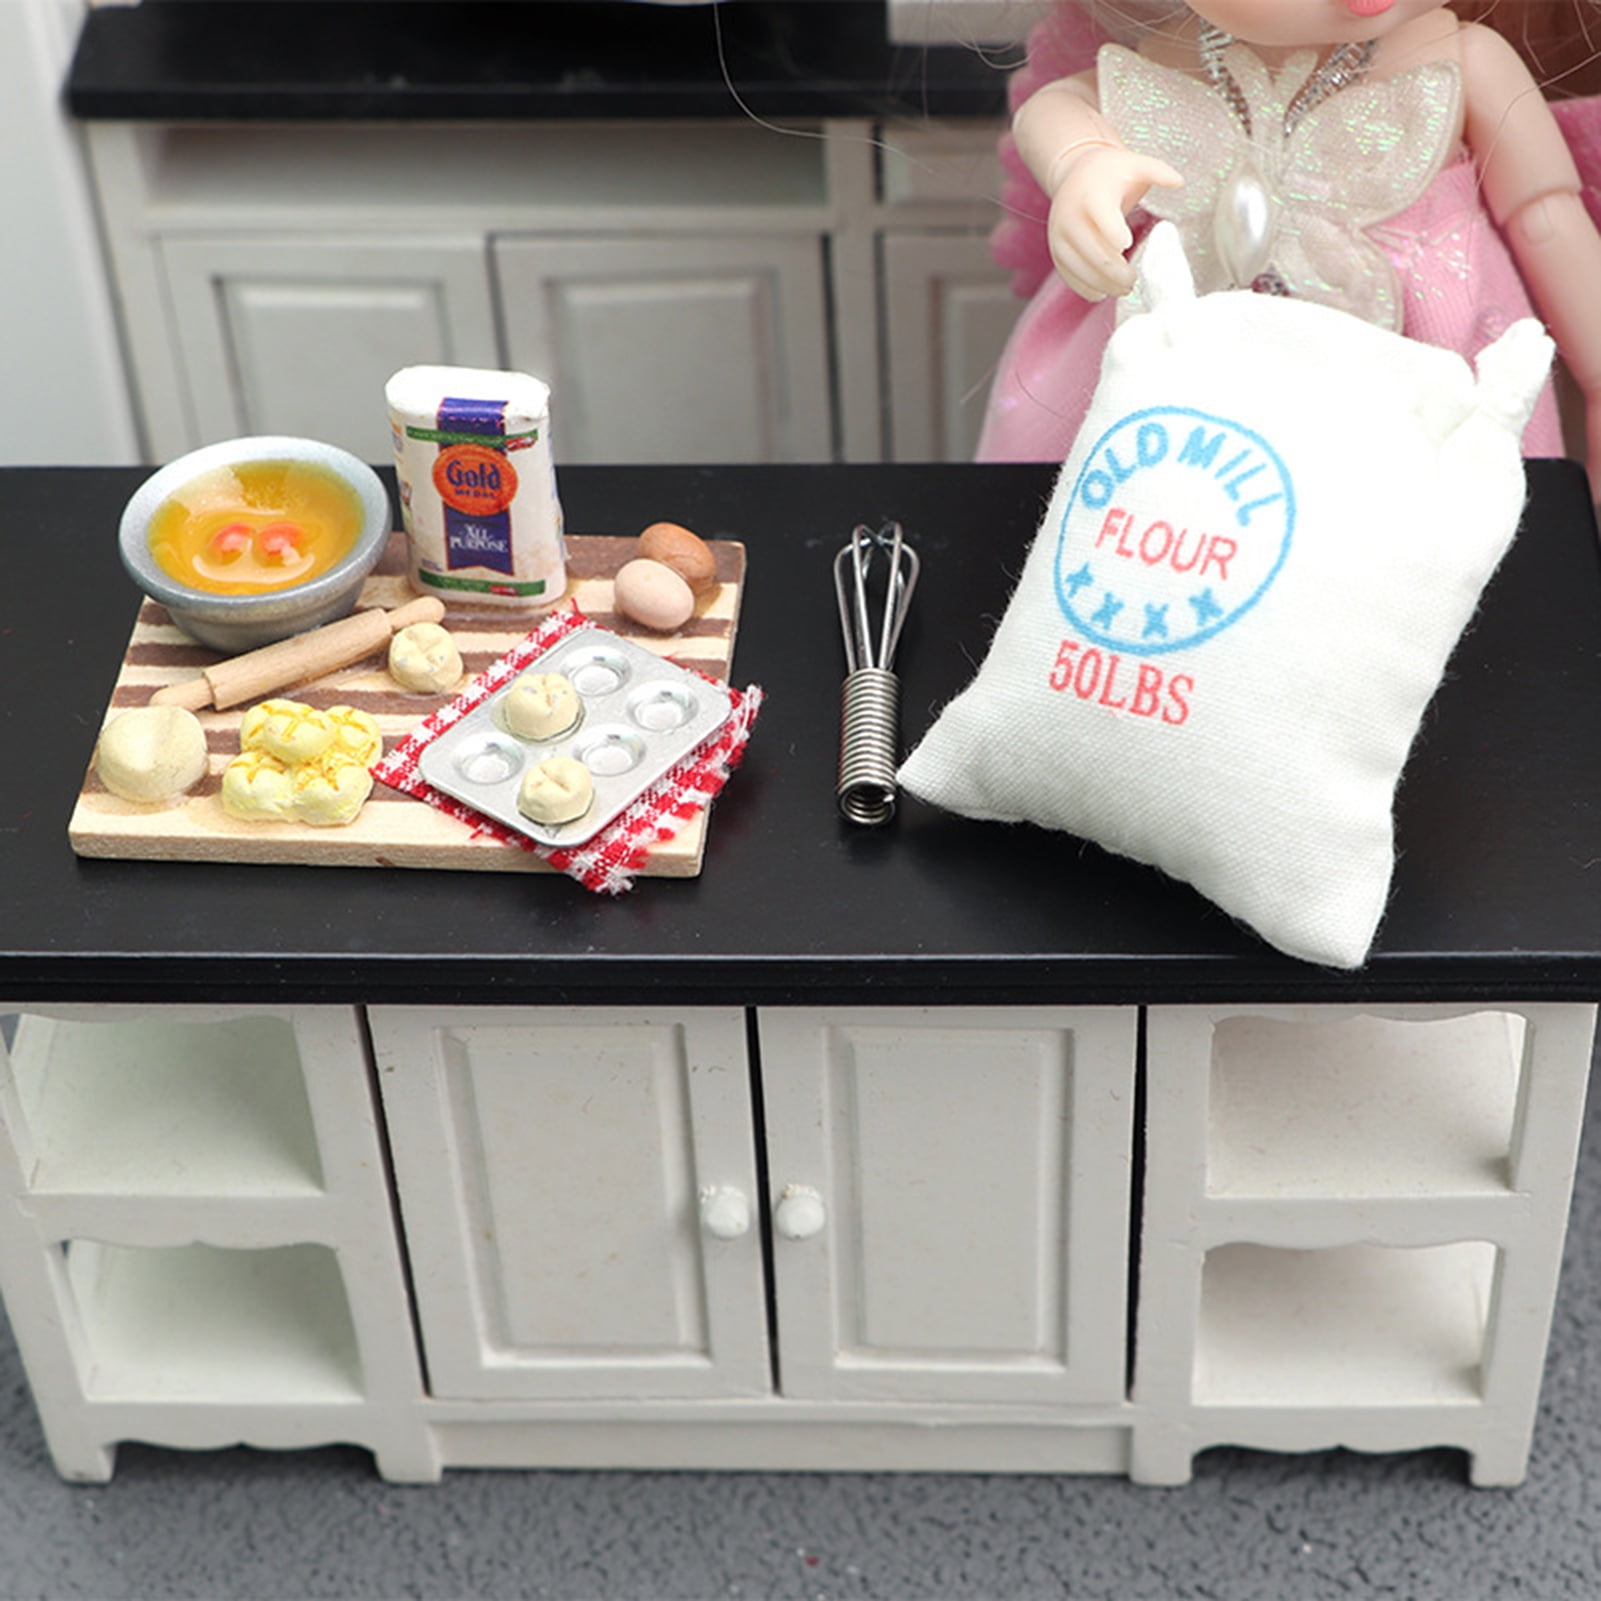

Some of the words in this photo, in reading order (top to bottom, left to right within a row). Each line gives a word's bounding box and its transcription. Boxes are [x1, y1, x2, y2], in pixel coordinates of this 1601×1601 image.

[446, 459, 501, 491] Gold
[1081, 422, 1169, 510] OLD
[1177, 425, 1284, 527] MILL
[1094, 507, 1239, 581] FLOUR
[1048, 639, 1195, 726] 50LBS
